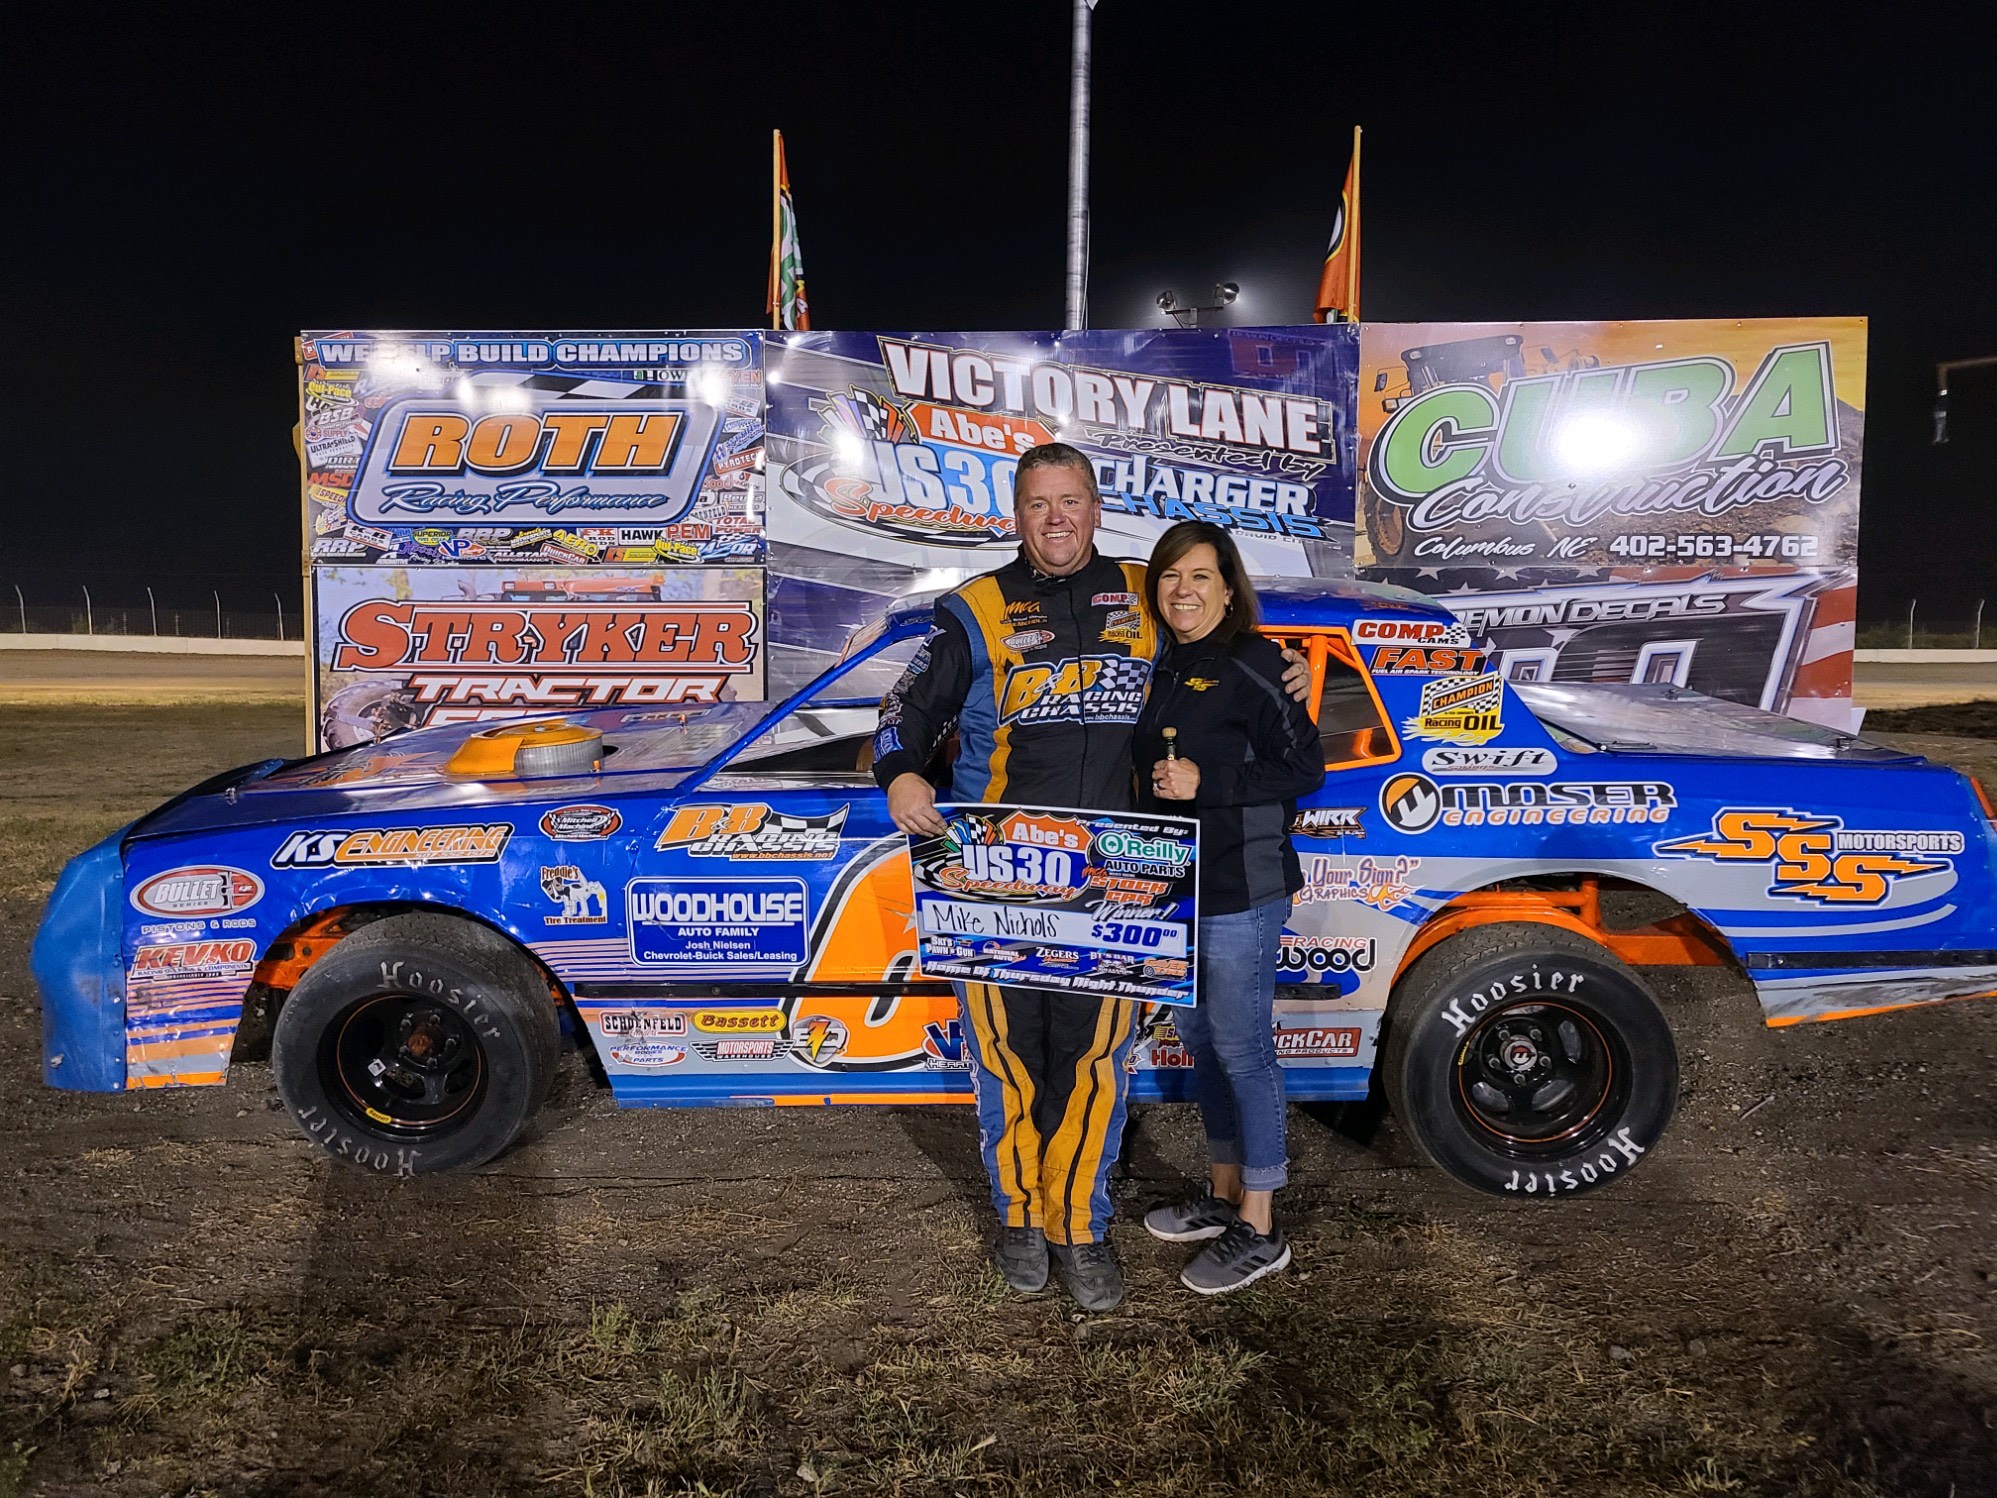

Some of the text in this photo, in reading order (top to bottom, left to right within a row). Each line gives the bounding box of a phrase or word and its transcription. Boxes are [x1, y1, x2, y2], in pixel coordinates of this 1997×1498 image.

[320, 344, 367, 362] WE
[458, 344, 549, 362] BUILD
[556, 341, 743, 362] CHAMPIONS
[883, 342, 1321, 453] VICTORY LANE
[1384, 344, 1832, 494] CUBA
[388, 411, 678, 471] ROTH
[930, 408, 1036, 453] Abe's
[718, 451, 763, 471] PYROTEC
[1099, 433, 1326, 481] Presented by
[1093, 454, 1309, 517] CHARGER
[1409, 458, 1848, 529] Construction
[382, 482, 672, 514] Racing Performance
[824, 477, 1018, 531] Speedwa
[553, 529, 598, 556] AERO
[621, 529, 664, 540] HAWK
[667, 524, 710, 540] PEM
[440, 539, 472, 557] VP
[699, 540, 758, 561] AZOR
[1414, 536, 1535, 560] Columbus
[1609, 535, 1819, 558] 402-563-4762
[1093, 593, 1128, 604] COMP
[1573, 593, 1728, 622] DECALS
[339, 601, 752, 668] STRYKER
[1126, 630, 1143, 639] OIL
[1357, 621, 1445, 640] COMP
[1417, 637, 1460, 645] CAMS
[1374, 648, 1484, 671] FAST
[411, 676, 727, 702] TRACTOR
[1002, 659, 1103, 720] B&B
[1040, 691, 1143, 705] RACING
[1432, 681, 1494, 710] CHAMPION
[1020, 702, 1139, 720] CHASSIS
[1424, 715, 1503, 731] Racing OIL
[1441, 783, 1676, 808] MOSER
[657, 803, 770, 846] B&B
[1443, 807, 1671, 825] ENGINEERING
[707, 832, 839, 843] RACING
[1011, 822, 1079, 848] Abe's
[1075, 819, 1189, 836] Presented By:
[274, 826, 509, 863] KS ENGINEERING
[689, 841, 839, 853] CHASSIS
[1100, 833, 1189, 864] O'Reilly
[1836, 832, 1962, 852] MOTORSPORTS
[732, 851, 834, 860] www.bbchassis.net
[961, 844, 1072, 886] US30
[1655, 811, 1951, 902] SSS
[541, 866, 579, 880] Freddie's
[1104, 859, 1186, 878] AUTO PARTS
[1312, 857, 1353, 888] Your
[154, 880, 223, 905] BULLET
[939, 866, 1077, 900] Speedway
[1090, 876, 1169, 895] STOCK
[632, 892, 803, 922] WOODHOUSE
[1104, 891, 1154, 906] CAR
[563, 915, 607, 924] Treatment
[932, 903, 1060, 938] Mike Nichols
[1084, 900, 1179, 921] Winner!
[141, 920, 206, 935] PISTONS
[222, 918, 257, 929] RODS
[677, 927, 760, 937] AUTO FAMILY
[685, 940, 751, 950] Josh Nielsen
[924, 943, 976, 958] PAWN GUN
[1292, 936, 1368, 948] RACING
[136, 942, 254, 970] KEVKO
[643, 951, 798, 963] Chevrolet-Buick Sales/Leasing
[1035, 946, 1080, 960] ZEGERS
[1276, 938, 1377, 973] wood
[925, 960, 972, 974] Home
[972, 966, 991, 979] Of
[992, 968, 1072, 987] Thursday
[1072, 976, 1116, 992] Night
[1116, 981, 1191, 1000] Thunder
[376, 961, 501, 1038] Hoosier
[1441, 963, 1585, 1039] Hoosier
[604, 1015, 682, 1031] SCHOENFELD
[701, 1013, 780, 1029] Bassett
[609, 1044, 688, 1053] PERFORMANCE
[717, 1040, 775, 1055] MOTORSPORTS
[1274, 1029, 1353, 1049] ICKCAR
[1504, 1126, 1646, 1197] Hoosier
